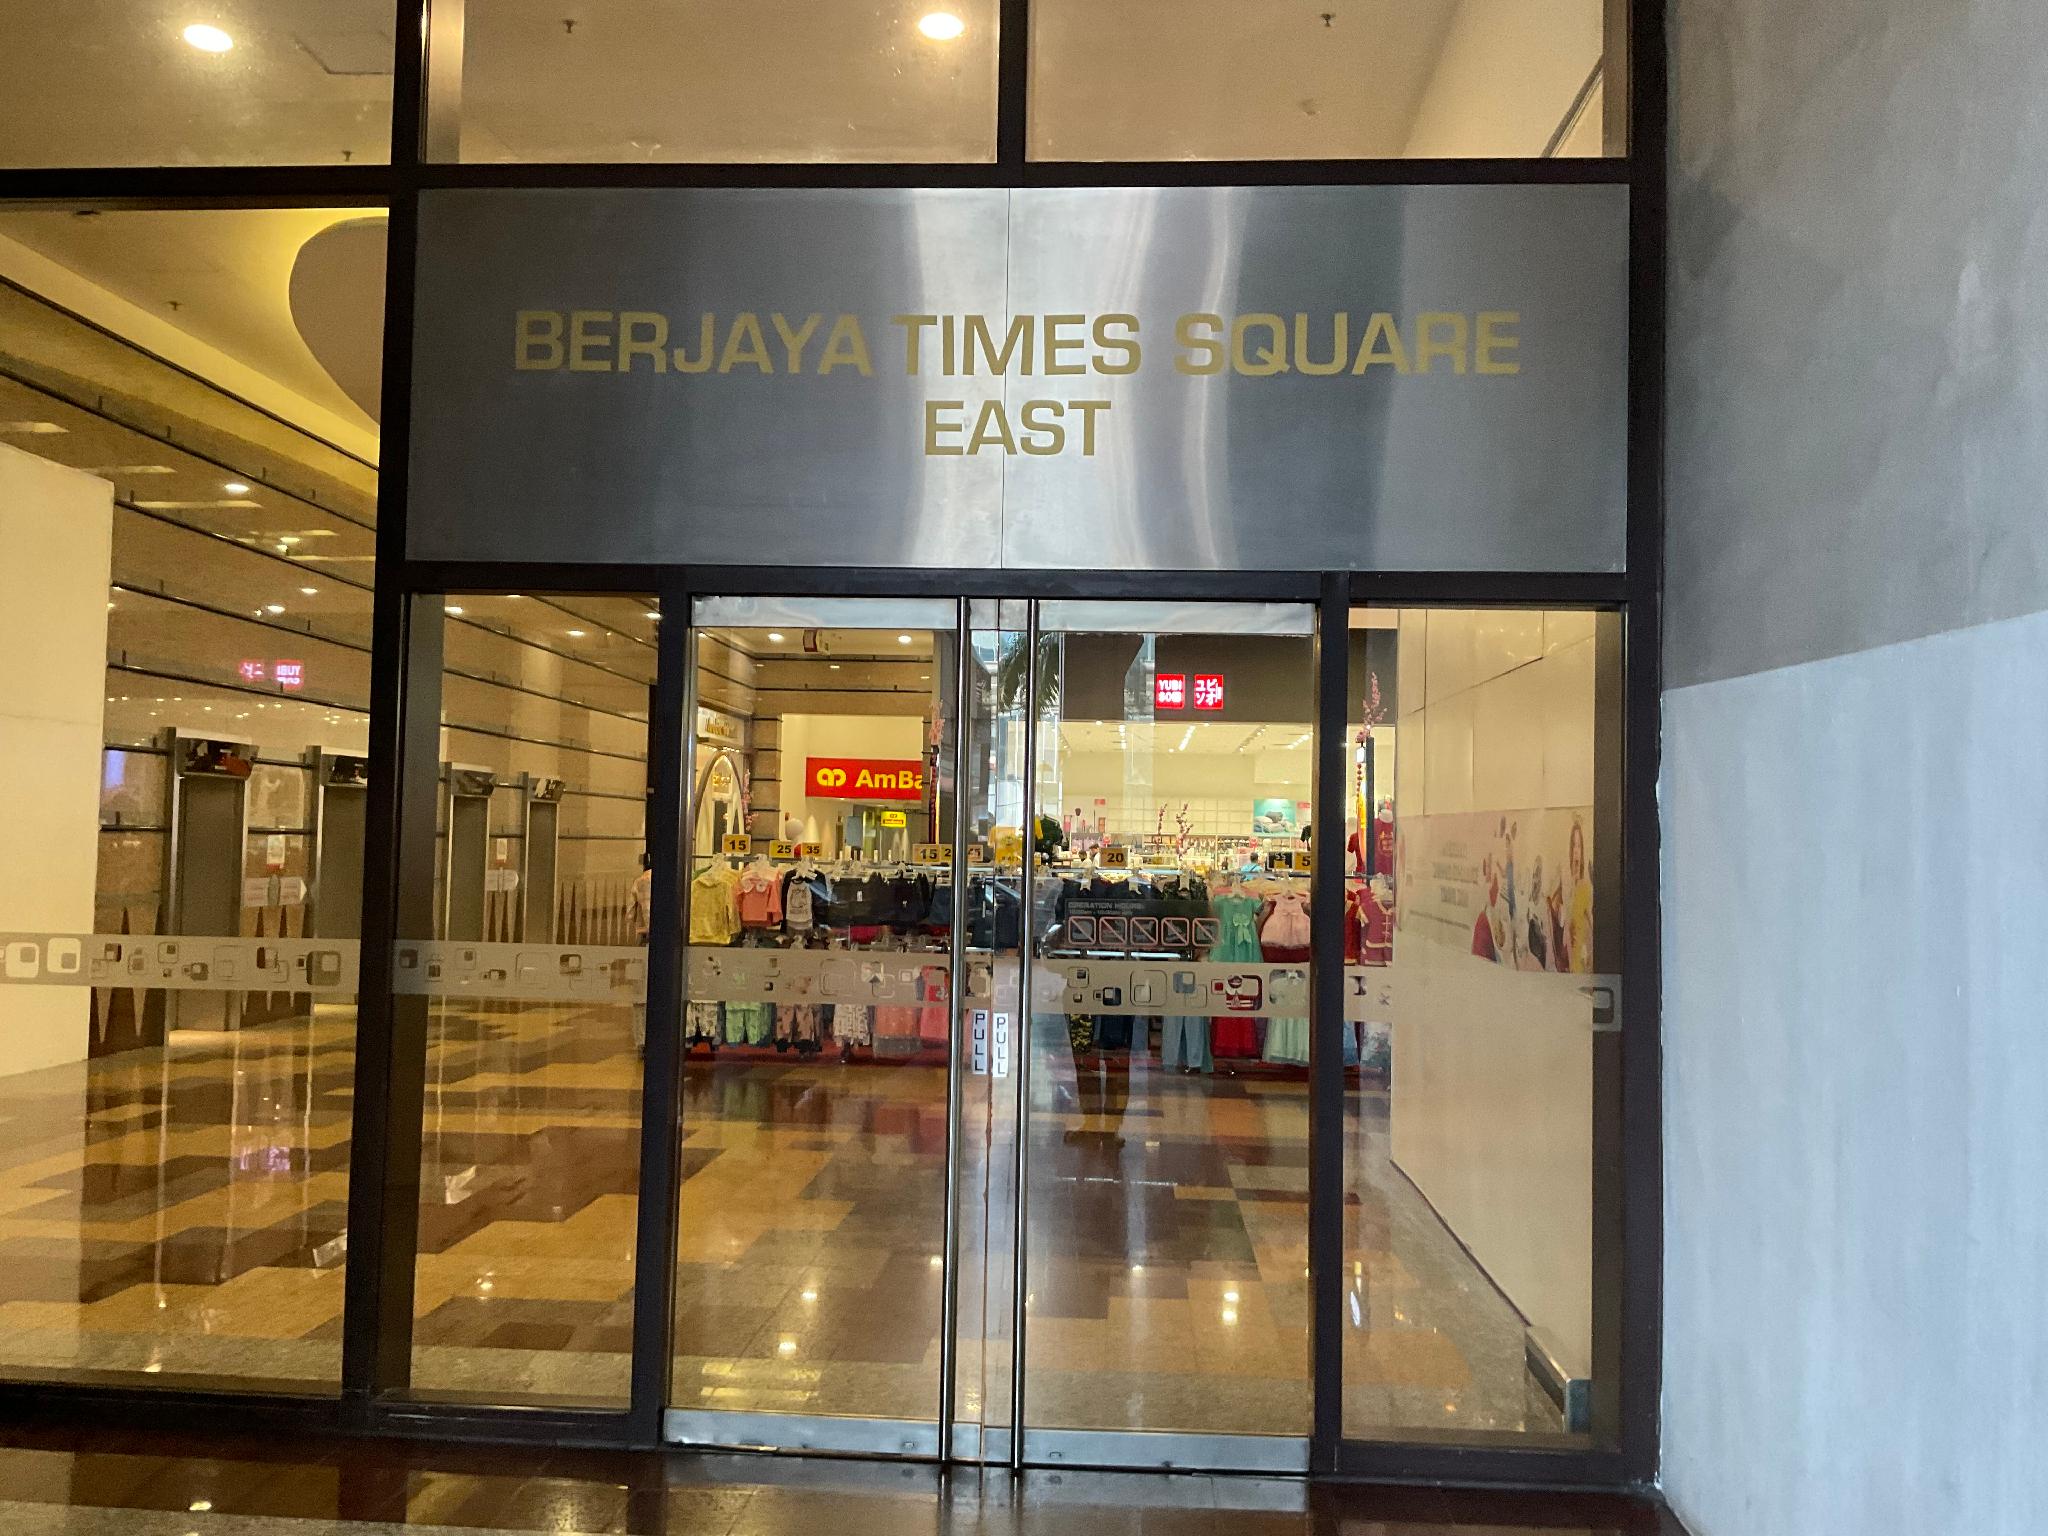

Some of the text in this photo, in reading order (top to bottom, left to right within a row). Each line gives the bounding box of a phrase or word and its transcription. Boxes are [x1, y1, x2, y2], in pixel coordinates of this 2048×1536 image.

[514, 310, 1521, 377] BERJAYA TIMES SQUARE
[925, 399, 1112, 456] EAST
[1158, 679, 1182, 691] YUBI
[729, 839, 747, 851] 15
[777, 844, 792, 854] 25
[806, 845, 820, 855] 35
[920, 848, 938, 860] 15
[1107, 852, 1124, 864] 20
[974, 1012, 986, 1072] PULL
[996, 1016, 1006, 1075] PULL
